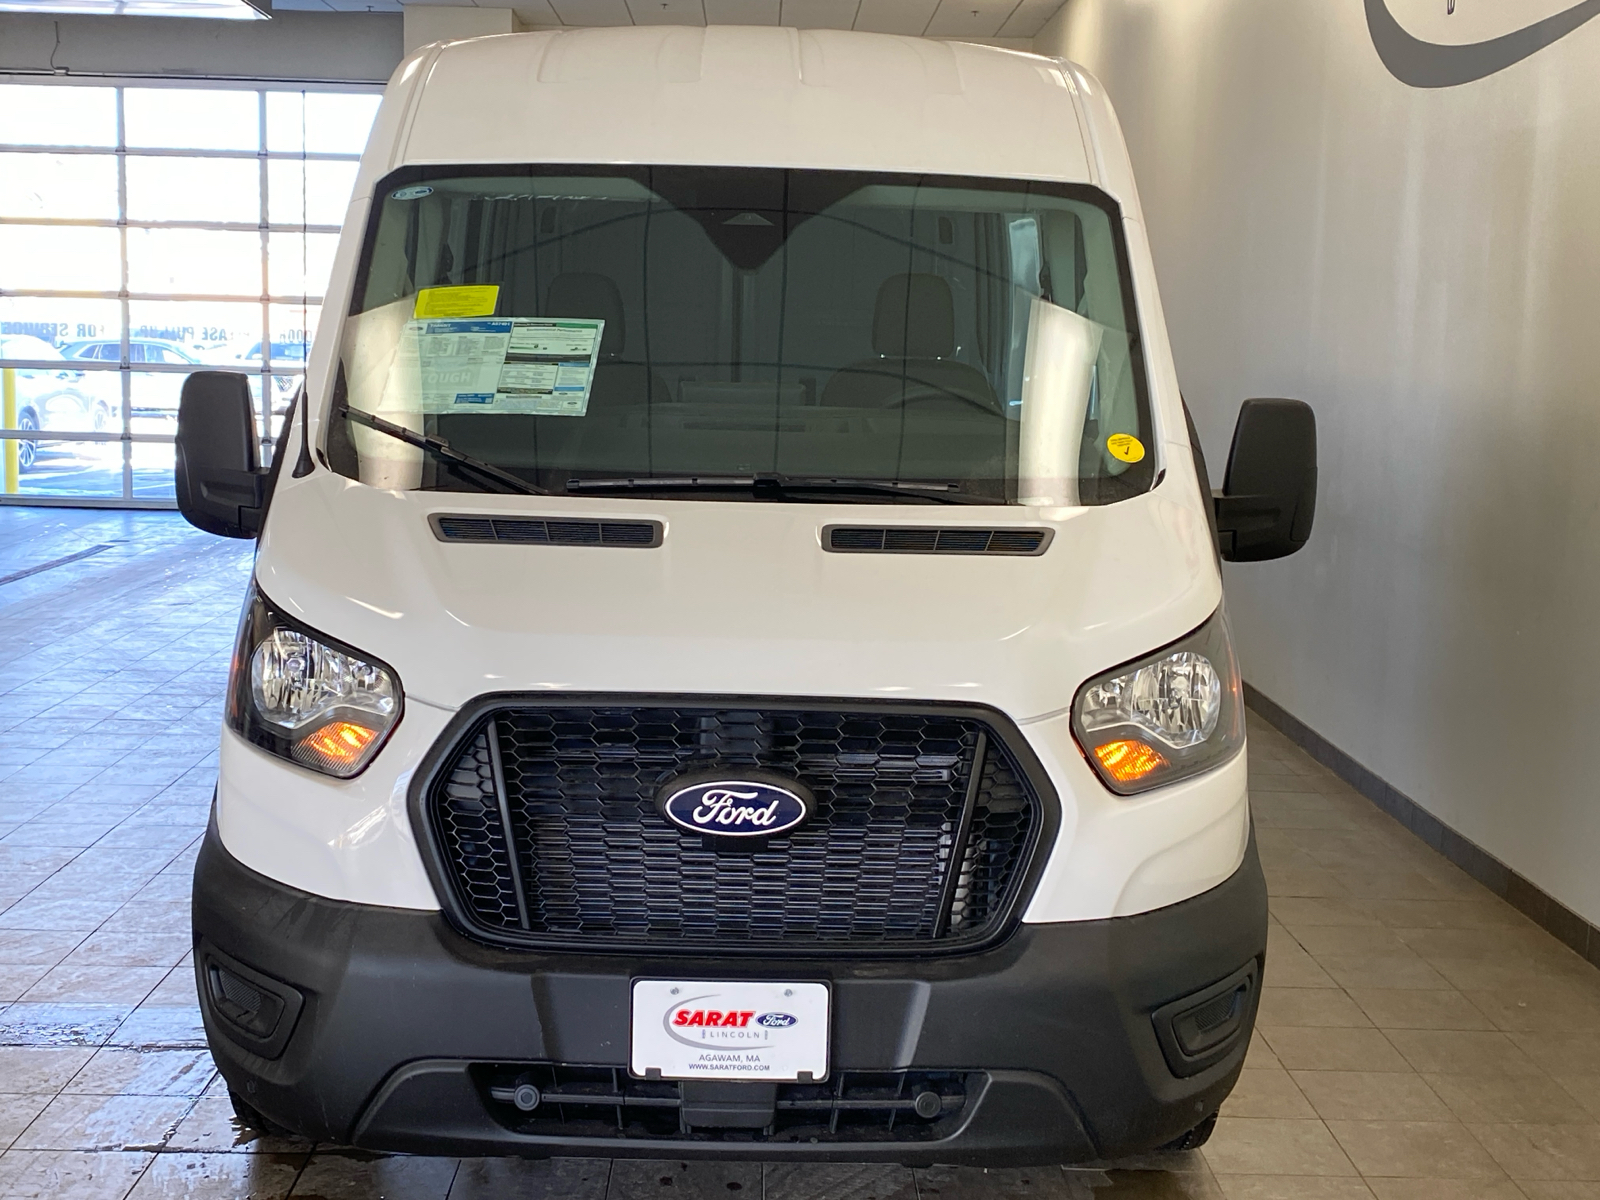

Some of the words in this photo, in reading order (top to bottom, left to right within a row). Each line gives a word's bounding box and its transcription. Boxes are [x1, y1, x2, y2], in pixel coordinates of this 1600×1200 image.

[692, 789, 780, 826] Ford
[672, 1008, 757, 1029] SARAT
[762, 1013, 791, 1027] Ford
[710, 1030, 761, 1039] LINCOLN
[698, 1053, 744, 1063] AGAWAM,
[746, 1054, 761, 1063] MA
[688, 1063, 771, 1072] WWW.SARATFORD.COM
